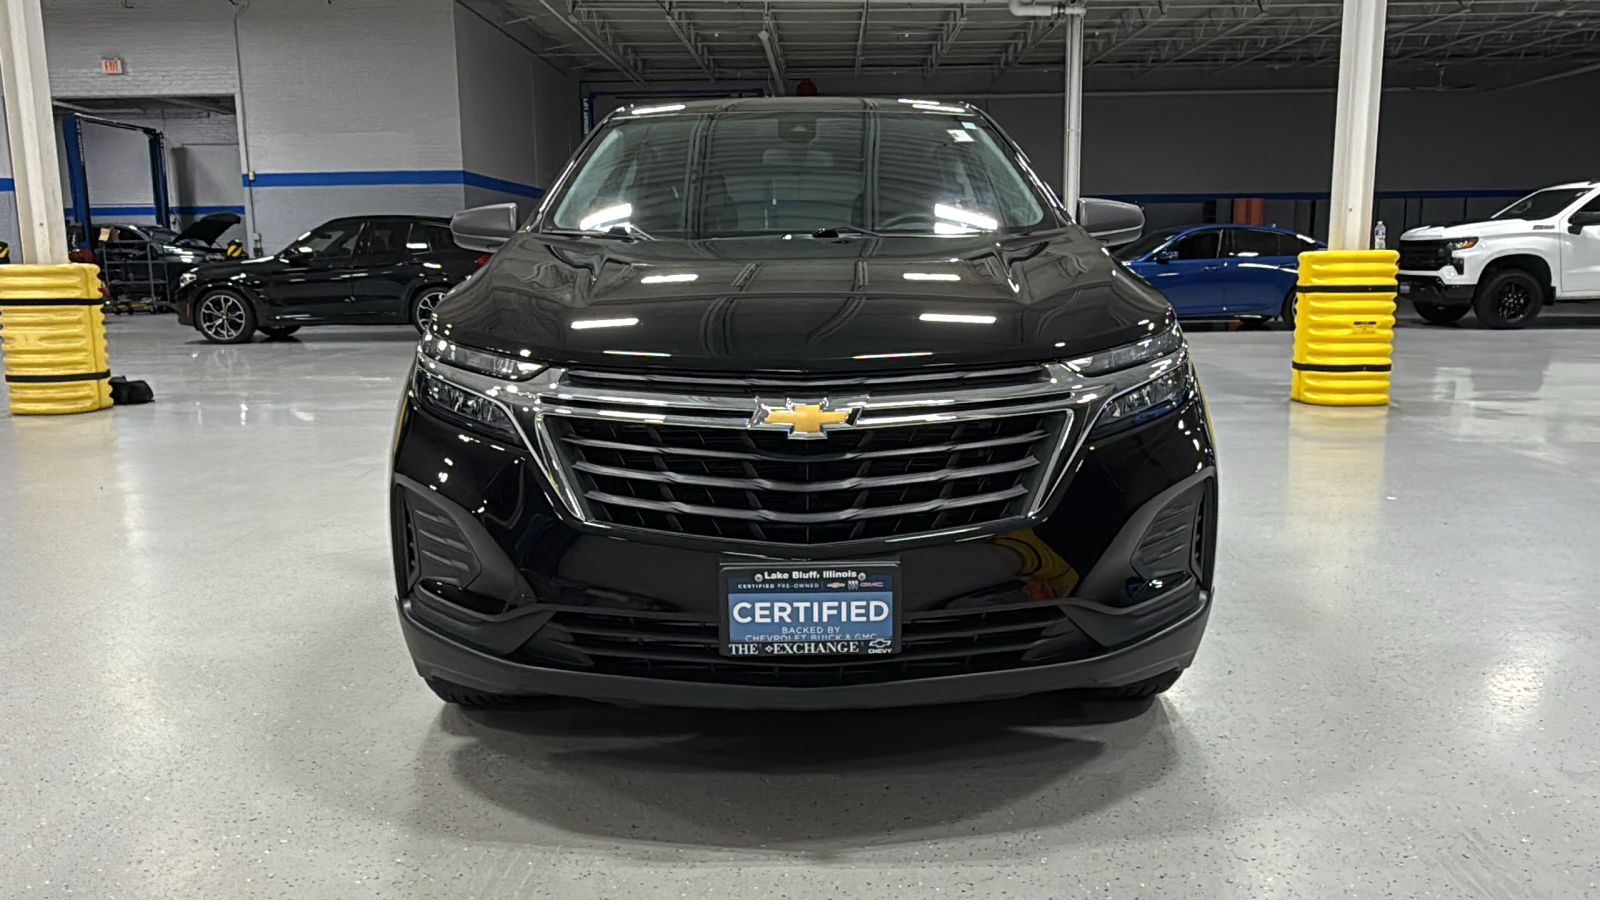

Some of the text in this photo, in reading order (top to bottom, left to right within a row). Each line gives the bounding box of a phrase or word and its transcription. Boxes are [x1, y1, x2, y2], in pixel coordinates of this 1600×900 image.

[763, 569, 858, 580] Lake Bluff, Illinois
[732, 600, 890, 624] CERTIFIED
[781, 626, 841, 635] BACKED BY
[745, 634, 807, 642] CHEVROLET
[810, 633, 842, 641] BUICK
[854, 632, 877, 640] GMC
[728, 641, 860, 655] THE EXCHANGE
